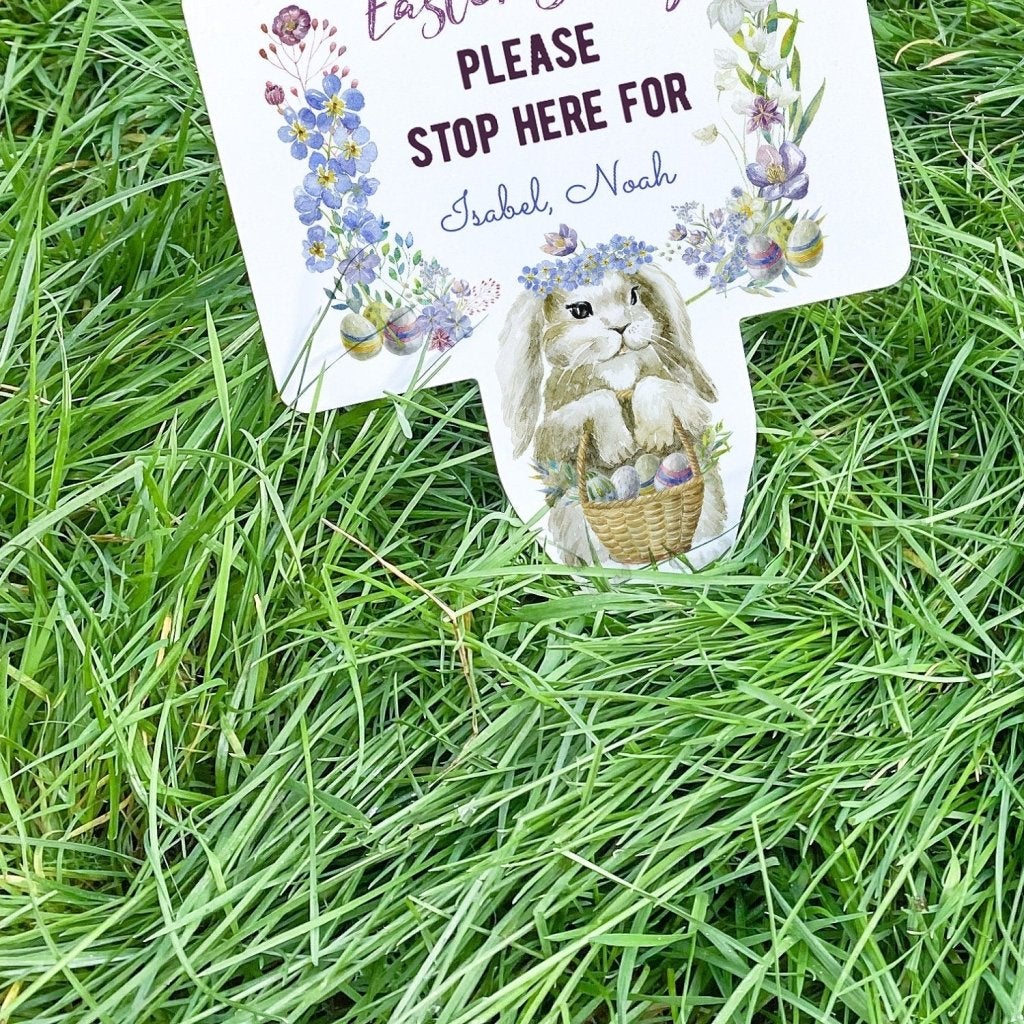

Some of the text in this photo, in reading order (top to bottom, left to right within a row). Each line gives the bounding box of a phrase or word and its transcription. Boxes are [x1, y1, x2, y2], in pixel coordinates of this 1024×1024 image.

[455, 21, 601, 91] PLEASE
[406, 71, 693, 168] STOP HERE FOR
[440, 150, 678, 233] Isabel, Noah
